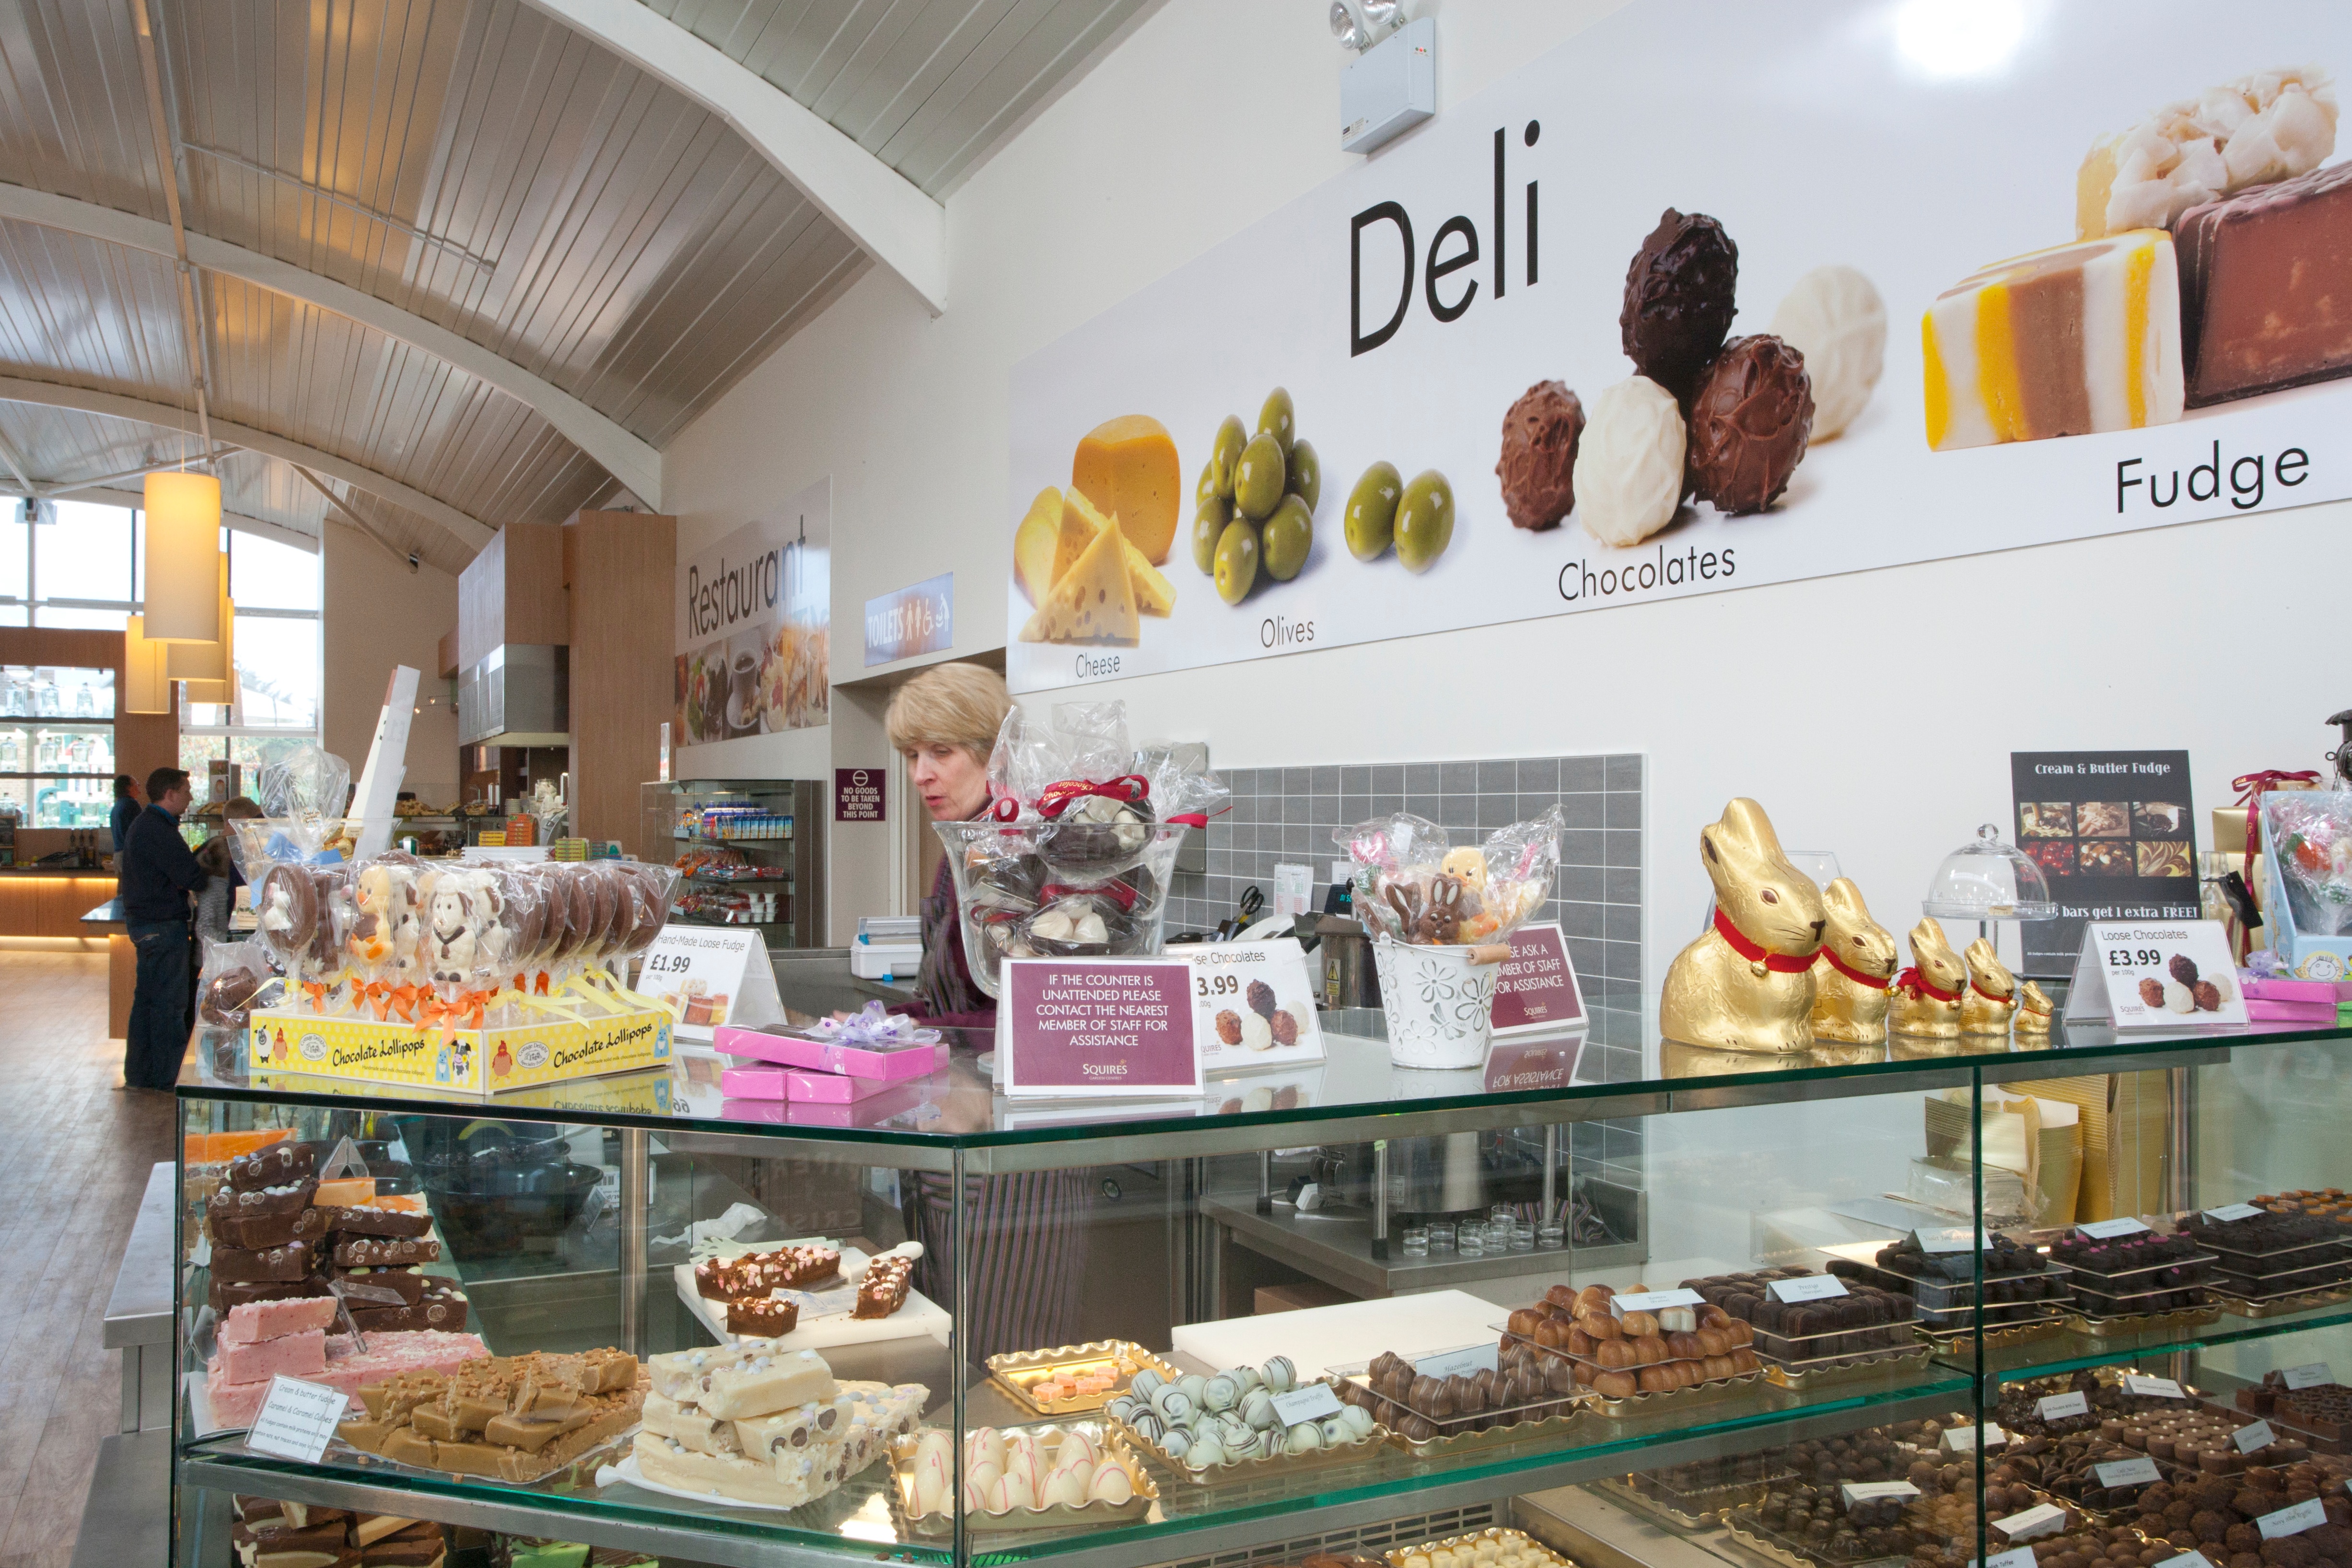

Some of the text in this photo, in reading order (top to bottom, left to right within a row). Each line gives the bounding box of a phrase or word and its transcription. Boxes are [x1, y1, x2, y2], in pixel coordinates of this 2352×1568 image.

[1351, 119, 1540, 358] Deli
[2117, 439, 2309, 513] Fudge
[689, 514, 806, 639] Restaurant
[1559, 545, 1735, 601] Chocolates
[868, 606, 904, 648] TOILETS
[1261, 616, 1315, 648] Olives
[1076, 653, 1120, 678] Cheese
[2035, 762, 2171, 776] Cream & Butter Fudge
[2062, 906, 2089, 918] bars
[2093, 906, 2113, 920] get
[2116, 906, 2121, 918] 1
[2125, 906, 2159, 918] extra
[2163, 906, 2198, 918] FREE!
[2101, 929, 2188, 941] Loose Chocolates
[658, 934, 745, 952] Hand-Made Loose Fudge
[1522, 944, 1539, 957] ASK
[1541, 943, 1549, 954] A
[650, 954, 691, 973] £1.99
[1211, 951, 1266, 964] Chocolates
[2109, 949, 2161, 966] £3.99
[1523, 961, 1536, 974] OF
[1539, 959, 1560, 972] STAFF
[2122, 969, 2135, 977] 100g
[1049, 975, 1154, 986] IF THE COUNTER IS
[1197, 975, 1238, 996] 3.99
[1514, 975, 1564, 993] ASSISTANCE
[1043, 990, 1161, 1001] UNATTENDED PLEASE
[1036, 1005, 1169, 1016] CONTACT THE NEAREST
[1524, 1006, 1548, 1016] SQUIRES
[2120, 1005, 2145, 1013] SQUIRES
[1038, 1020, 1168, 1031] MEMBER OF STAFF FOR
[554, 1023, 653, 1068] Chocolate Lollipops
[1070, 1035, 1139, 1046] ASSISTANCE
[333, 1038, 425, 1067] Chocolate Lollipops
[518, 1043, 548, 1057] Cottage Delight
[1200, 1045, 1222, 1053] QUIRES
[1083, 1063, 1128, 1075] SQUIRES
[1444, 1360, 1472, 1373] Hazelnut
[279, 1384, 294, 1394] Cream
[300, 1388, 317, 1400] butter
[1286, 1393, 1324, 1408] Champagne Truffle
[268, 1401, 288, 1412] Caramel
[292, 1407, 314, 1418] Caramel
[265, 1418, 277, 1427] fudges
[296, 1426, 311, 1435] proteins
